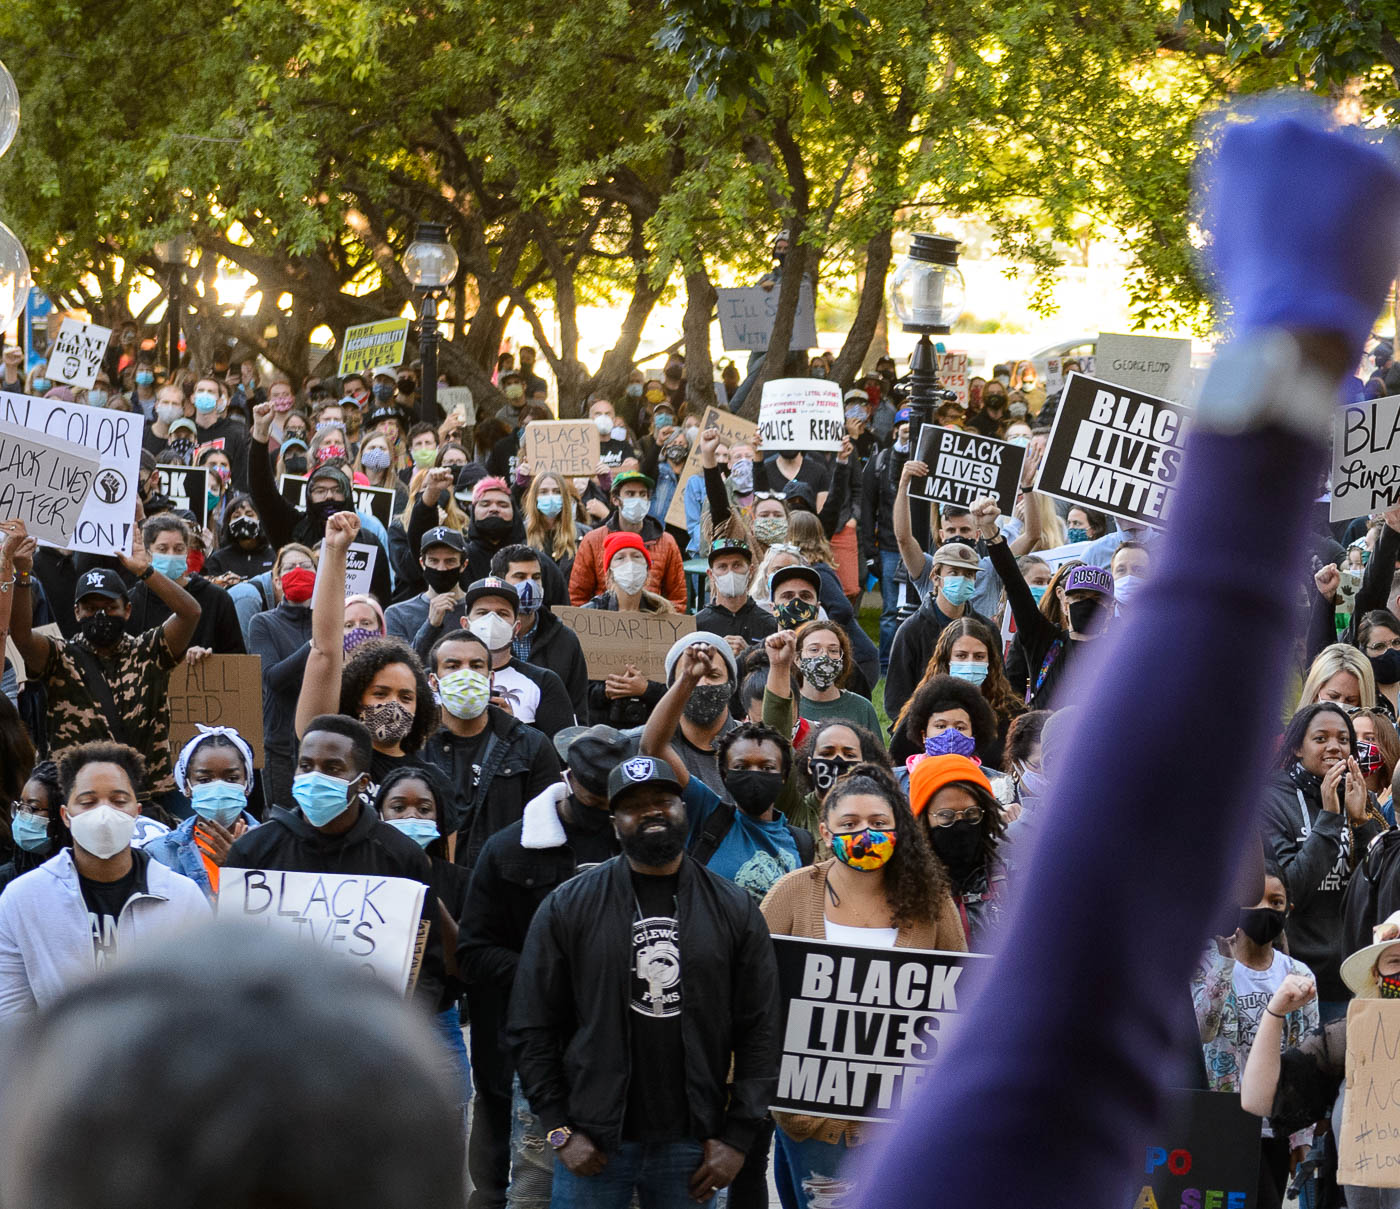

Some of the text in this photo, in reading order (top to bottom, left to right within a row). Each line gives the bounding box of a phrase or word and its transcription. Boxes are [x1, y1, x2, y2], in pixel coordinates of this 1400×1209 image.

[350, 326, 374, 338] MORE
[344, 355, 395, 373] LIVES
[345, 350, 367, 361] MORE
[1112, 359, 1146, 373] GEORGE
[533, 427, 590, 445] BLACK
[759, 418, 795, 442] POLICE
[535, 444, 590, 459] LIVES
[939, 433, 1005, 465] BLACK
[1087, 428, 1182, 483] LIVES
[0, 439, 92, 505] LACK LIVES
[534, 459, 592, 473] MATTER
[941, 456, 994, 487] LIVES
[0, 483, 70, 536] ATTER
[86, 572, 105, 588] NY
[1073, 569, 1112, 592] BOSTON
[561, 610, 684, 642] SOLIDARITY
[186, 660, 240, 692] ALL
[243, 870, 387, 924] BLACK
[801, 953, 964, 1011] BLACK
[806, 1006, 940, 1061] LIVES
